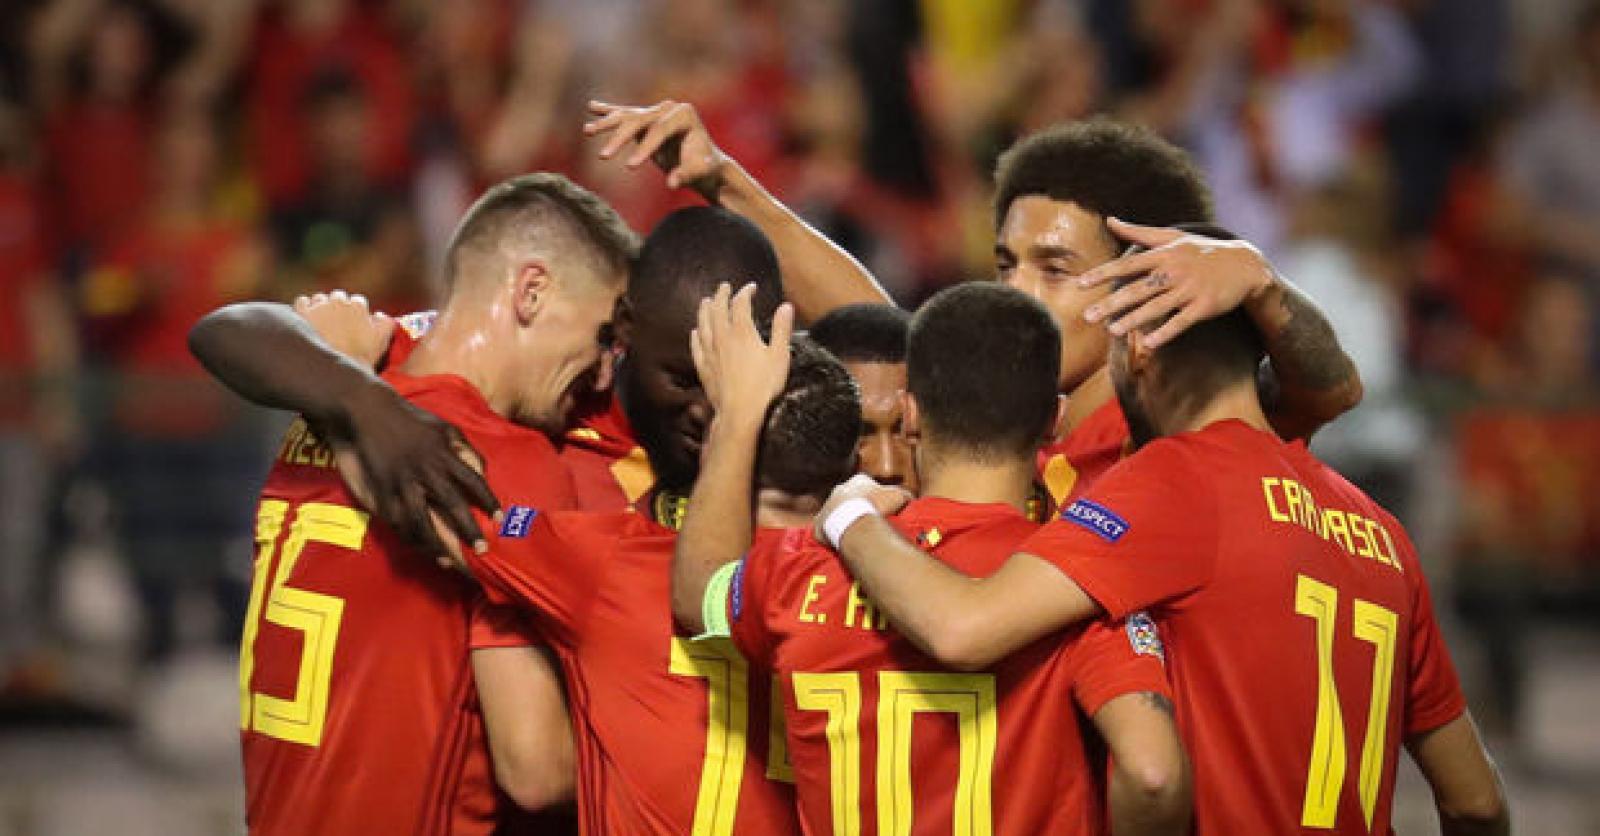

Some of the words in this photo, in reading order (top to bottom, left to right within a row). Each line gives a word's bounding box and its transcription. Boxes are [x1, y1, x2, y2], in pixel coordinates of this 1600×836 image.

[1065, 502, 1123, 536] RESPECT
[240, 499, 370, 747] 15
[1295, 573, 1398, 833] 17
[792, 671, 997, 836] 10
